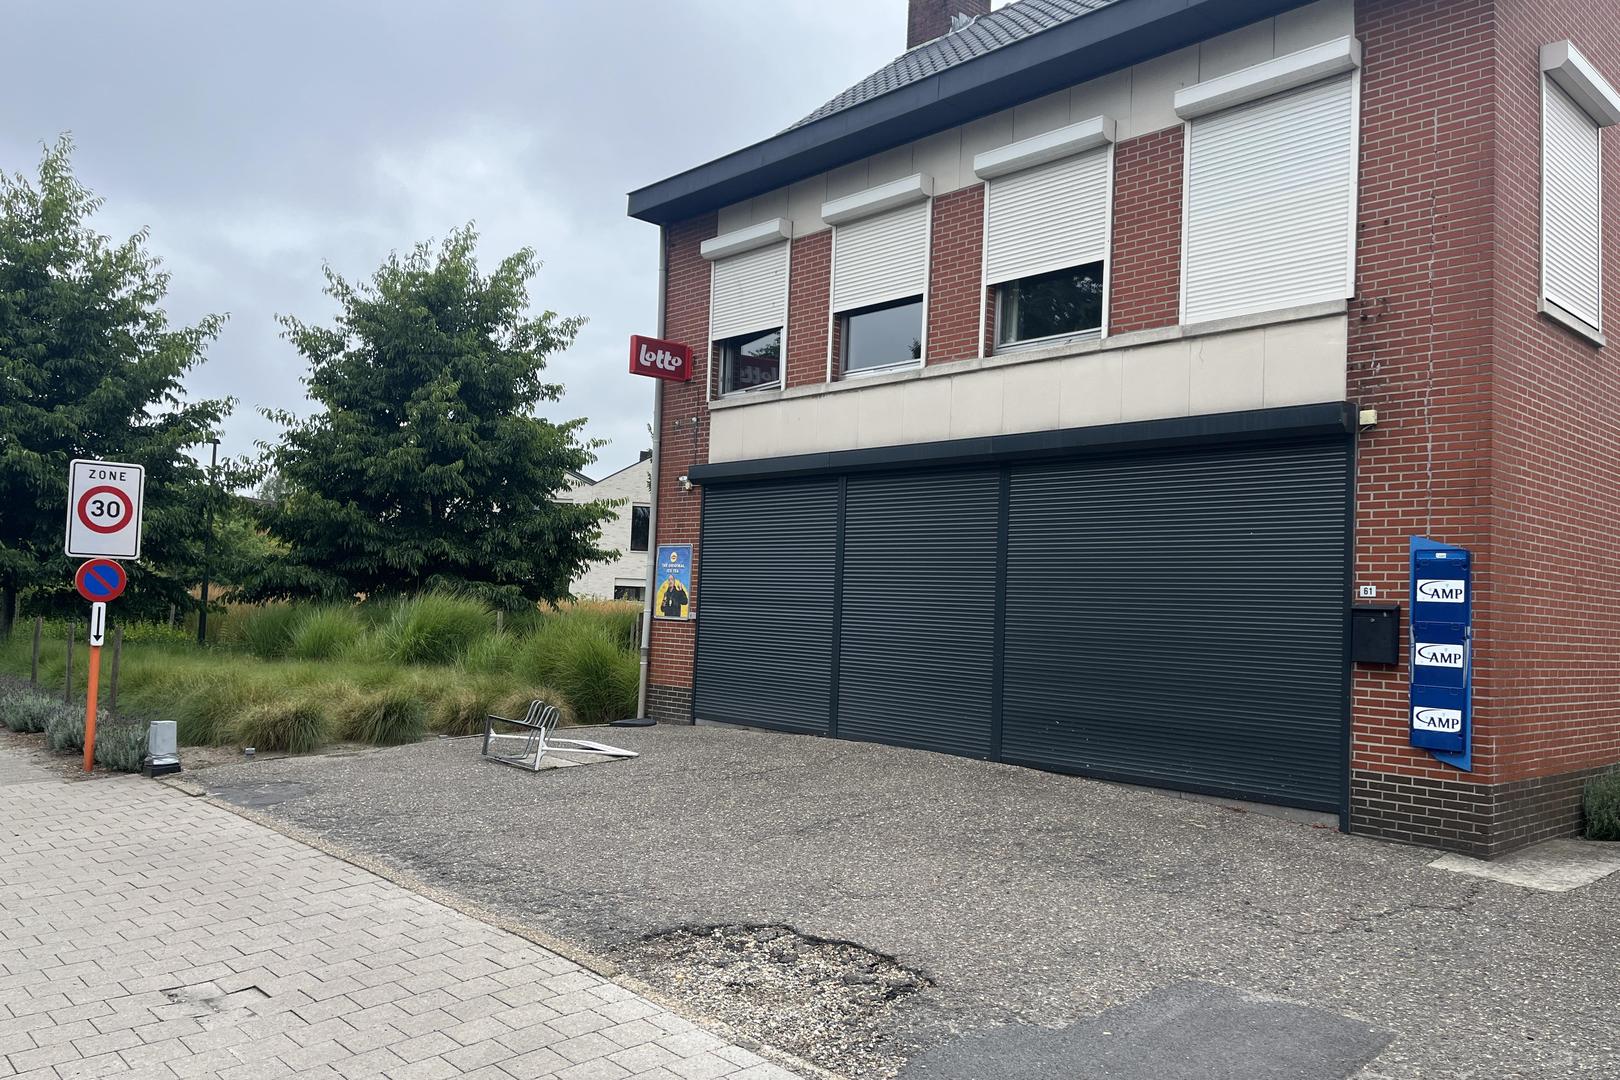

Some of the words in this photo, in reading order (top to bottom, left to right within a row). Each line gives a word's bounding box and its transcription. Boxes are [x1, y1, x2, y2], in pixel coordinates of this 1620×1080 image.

[639, 344, 683, 371] Lotto
[88, 469, 127, 481] ZONE
[90, 500, 120, 518] 30
[1363, 587, 1373, 595] 61
[1419, 581, 1463, 599] CAMP
[1418, 644, 1462, 664] CAMP
[1416, 708, 1460, 729] CAMP
